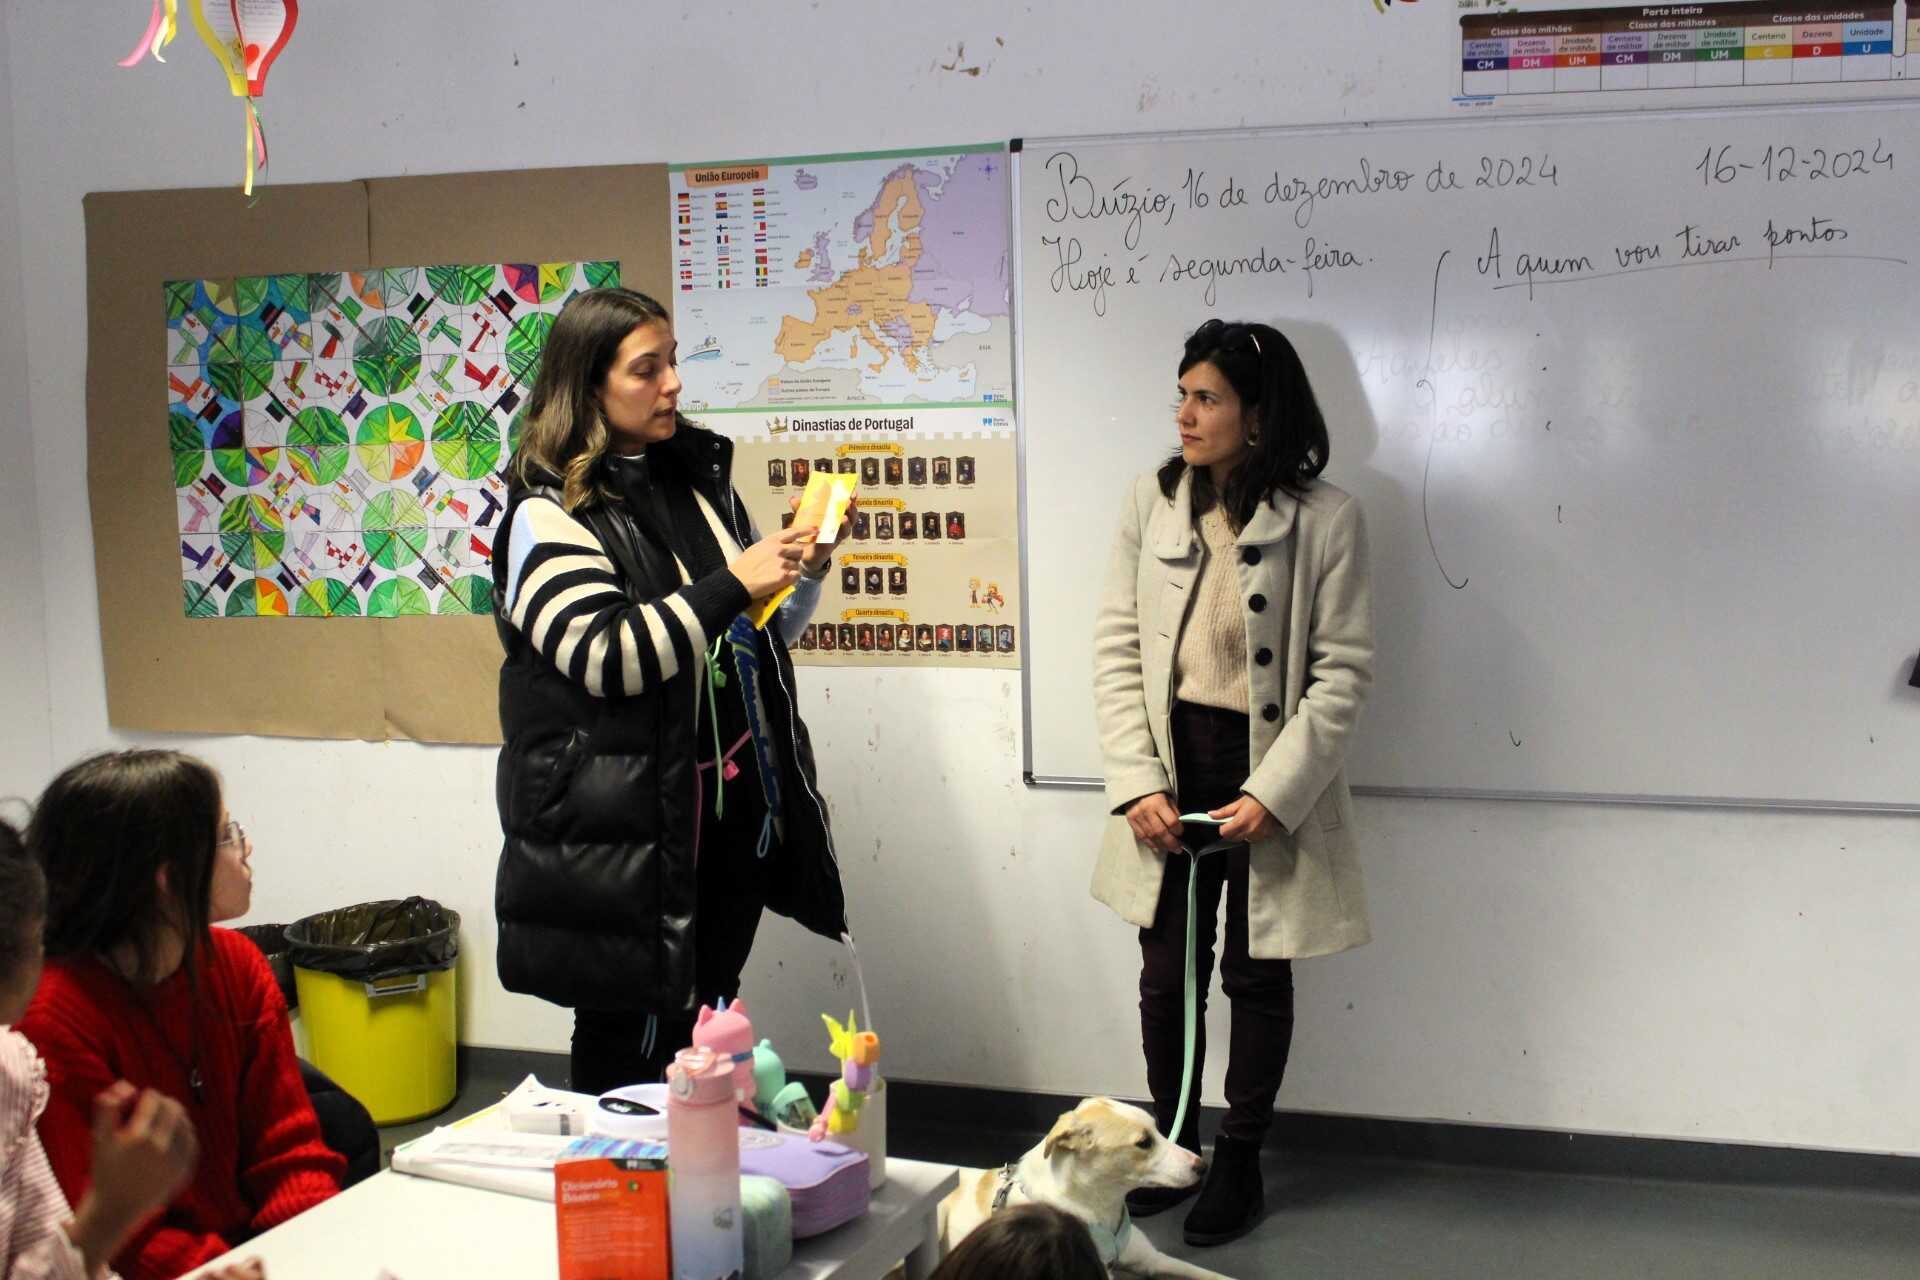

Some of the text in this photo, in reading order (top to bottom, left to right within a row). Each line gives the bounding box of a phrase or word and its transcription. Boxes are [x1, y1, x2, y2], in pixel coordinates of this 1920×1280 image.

[1643, 6, 1703, 16] Parte inteira
[1772, 14, 1802, 23] Classe
[1823, 11, 1864, 20] unidades
[1629, 20, 1658, 29] Classe
[1678, 18, 1717, 27] milhares
[1491, 27, 1519, 36] Classe
[1703, 30, 1737, 38] Unidade
[1751, 32, 1786, 40] Centena
[1850, 28, 1884, 36] Unidade
[1763, 48, 1773, 57] C
[1812, 46, 1822, 56] D
[1862, 43, 1871, 53] U
[1615, 54, 1634, 63] CM
[1662, 52, 1681, 61] DM
[1710, 50, 1729, 60] UM
[1476, 60, 1495, 69] CM
[1522, 58, 1540, 67] DM
[1569, 56, 1586, 65] UM
[1696, 138, 1894, 185] 16-12-2024
[695, 169, 760, 183] União Europeia
[1181, 168, 1209, 208] 16
[1219, 177, 1249, 207] de
[1265, 158, 1415, 228] dezembro
[1426, 160, 1463, 192] de
[1475, 153, 1559, 188] 2024
[1477, 217, 1849, 301] A quem vou tirar pontos
[1042, 236, 1116, 317] Hoje
[1126, 254, 1149, 284] é
[792, 416, 914, 432] Dinastias de Portugal
